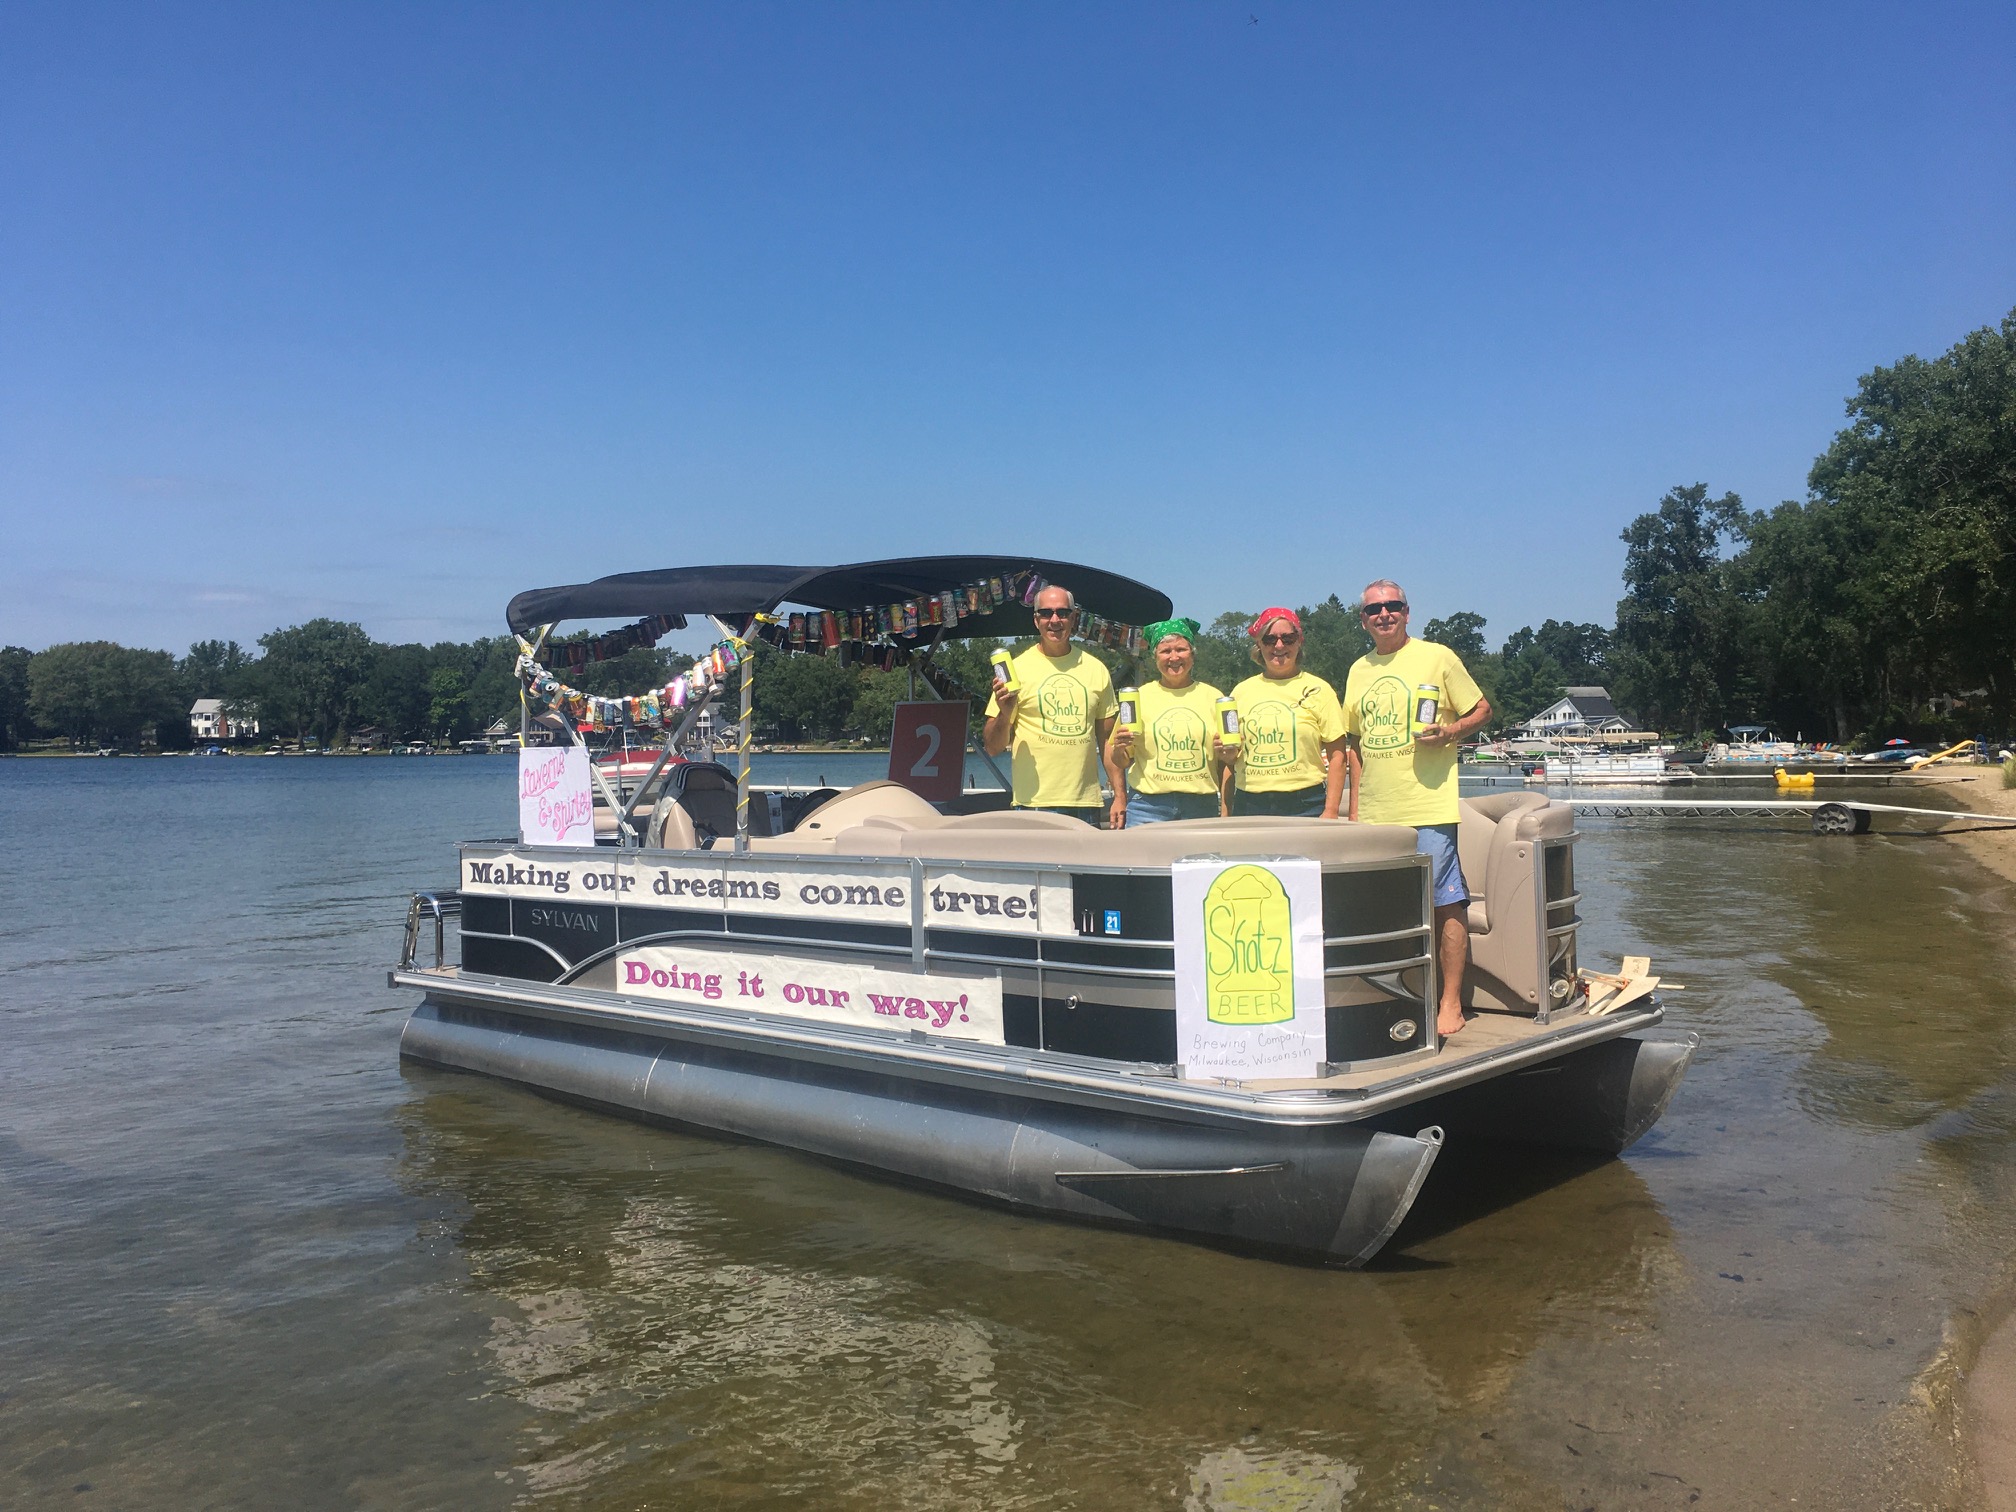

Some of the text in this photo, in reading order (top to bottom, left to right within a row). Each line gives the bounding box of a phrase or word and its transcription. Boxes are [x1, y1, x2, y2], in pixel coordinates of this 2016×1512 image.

[1052, 725, 1082, 733] BEER
[910, 724, 940, 777] 2
[1038, 735, 1077, 746] MILWAUKEE
[1367, 736, 1400, 746] BEER
[1165, 760, 1197, 769] BEER
[1252, 753, 1287, 763] BEER
[469, 862, 1038, 919] Making our dreams come true!
[531, 908, 599, 932] SYLVAN
[1106, 915, 1118, 929] 21
[1208, 905, 1289, 976] Shotz
[623, 960, 970, 1029] Doing it our way!
[1217, 992, 1287, 1016] BEER
[1193, 1030, 1307, 1054] Brewing Company
[1188, 1047, 1312, 1068] Milwaukee, Wisconsin
